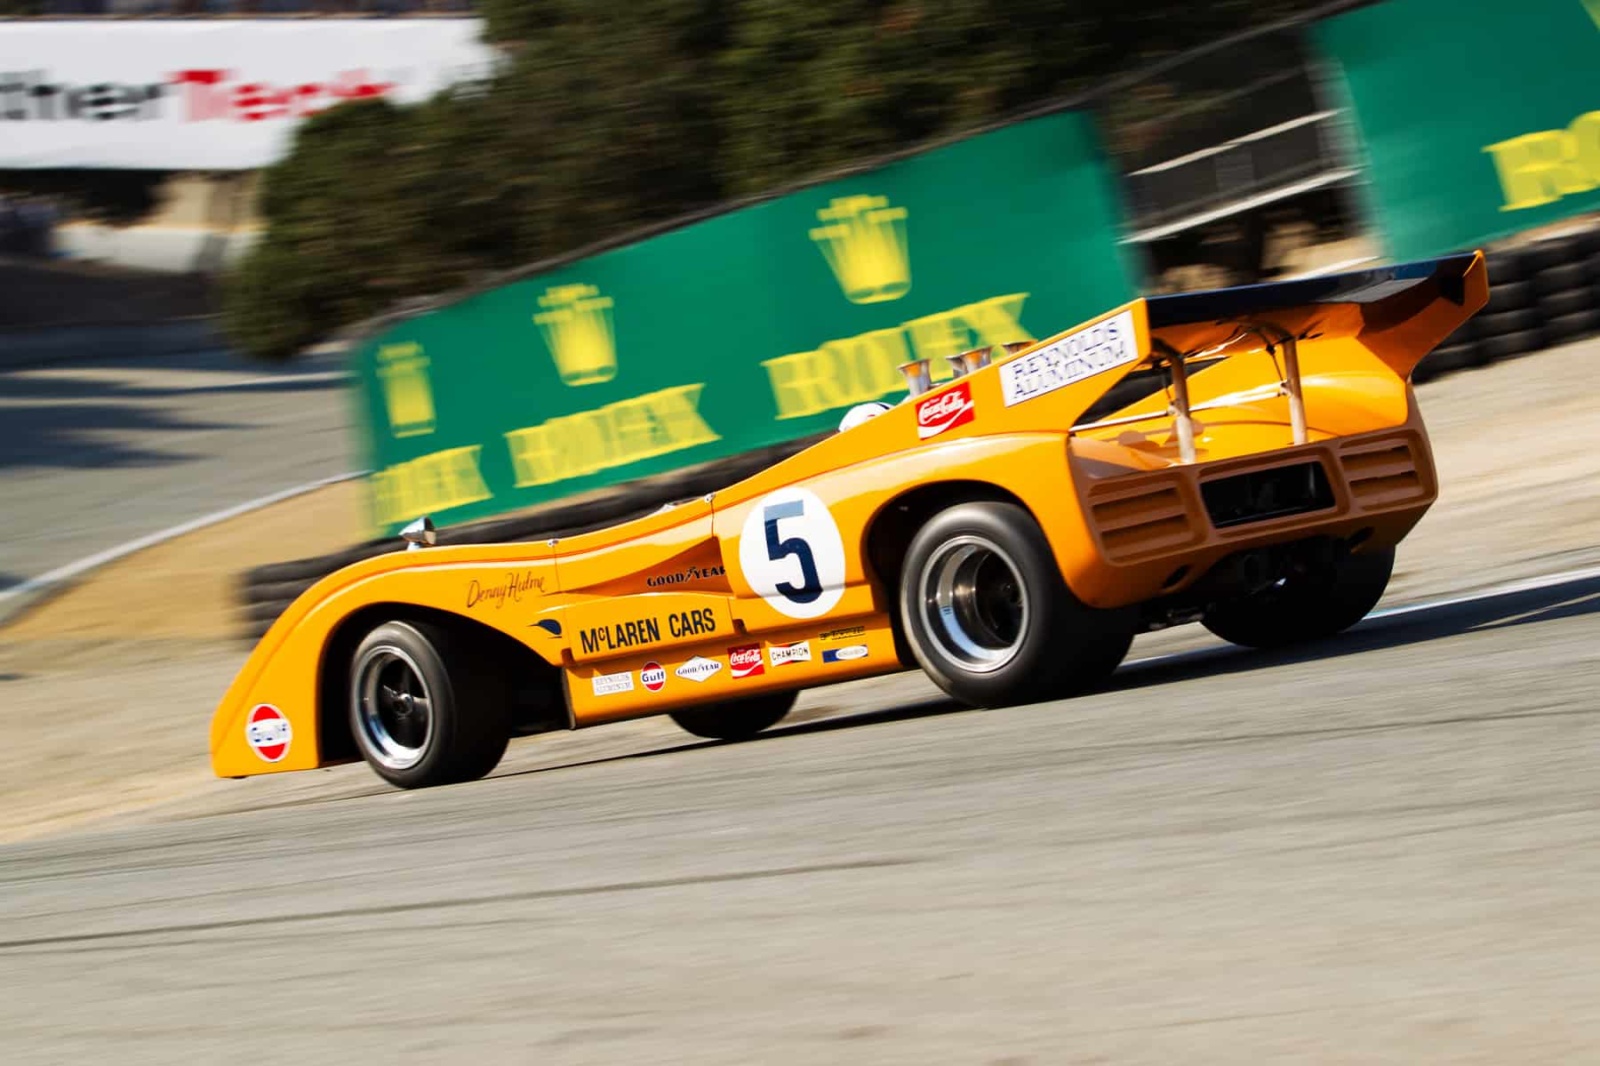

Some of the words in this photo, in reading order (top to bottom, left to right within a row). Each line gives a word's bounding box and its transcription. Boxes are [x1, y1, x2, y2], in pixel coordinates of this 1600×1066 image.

[764, 499, 823, 604] 5
[669, 607, 716, 638] CARS
[771, 646, 809, 661] CHAMPION
[641, 671, 664, 683] Gulf
